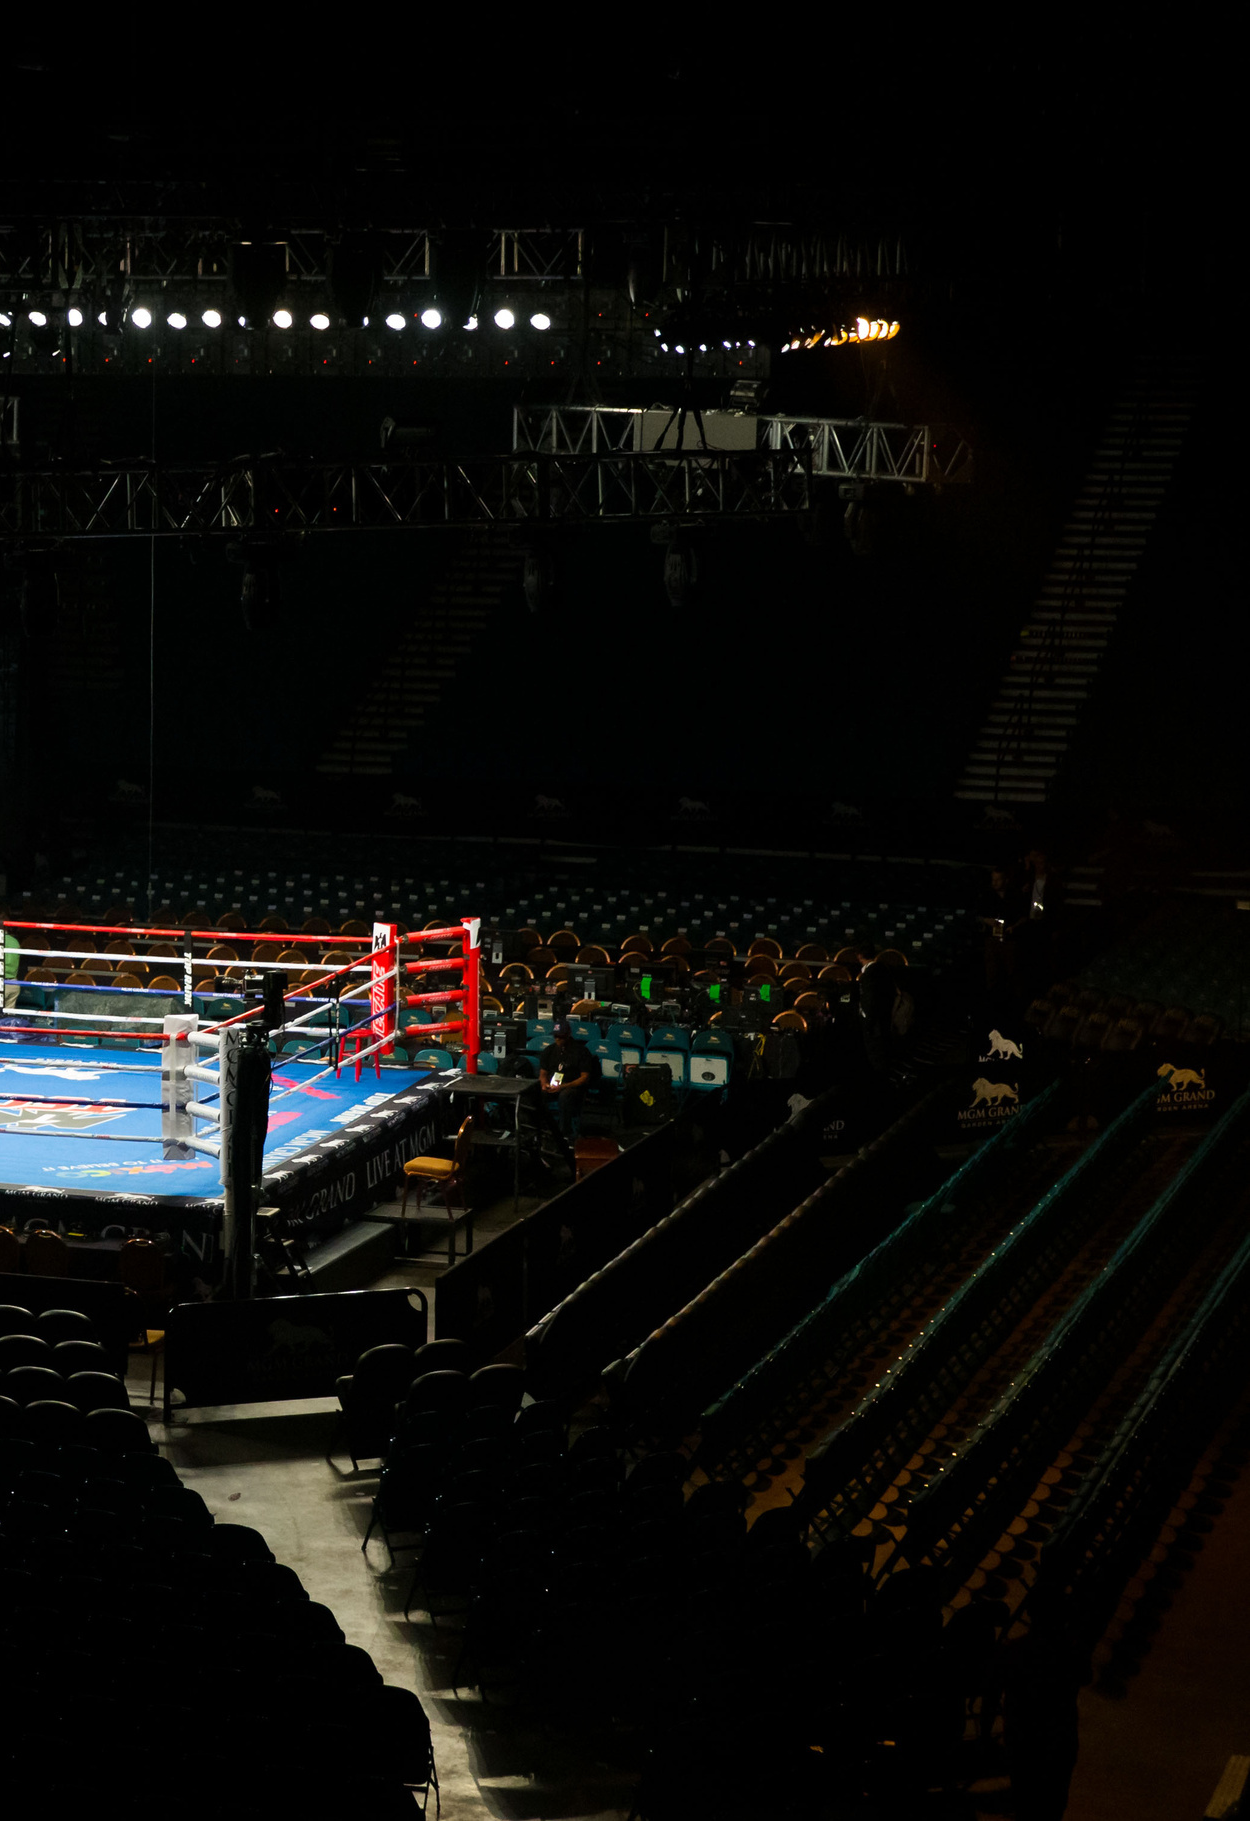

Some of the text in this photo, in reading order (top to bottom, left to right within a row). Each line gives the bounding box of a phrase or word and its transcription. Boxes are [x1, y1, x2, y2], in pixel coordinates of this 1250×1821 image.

[183, 952, 192, 1007] TOP RANK
[957, 1107, 986, 1121] MGM
[1174, 1089, 1216, 1103] GRAND
[365, 1120, 436, 1189] LIVE AT MGM
[306, 1171, 356, 1221] GRAND
